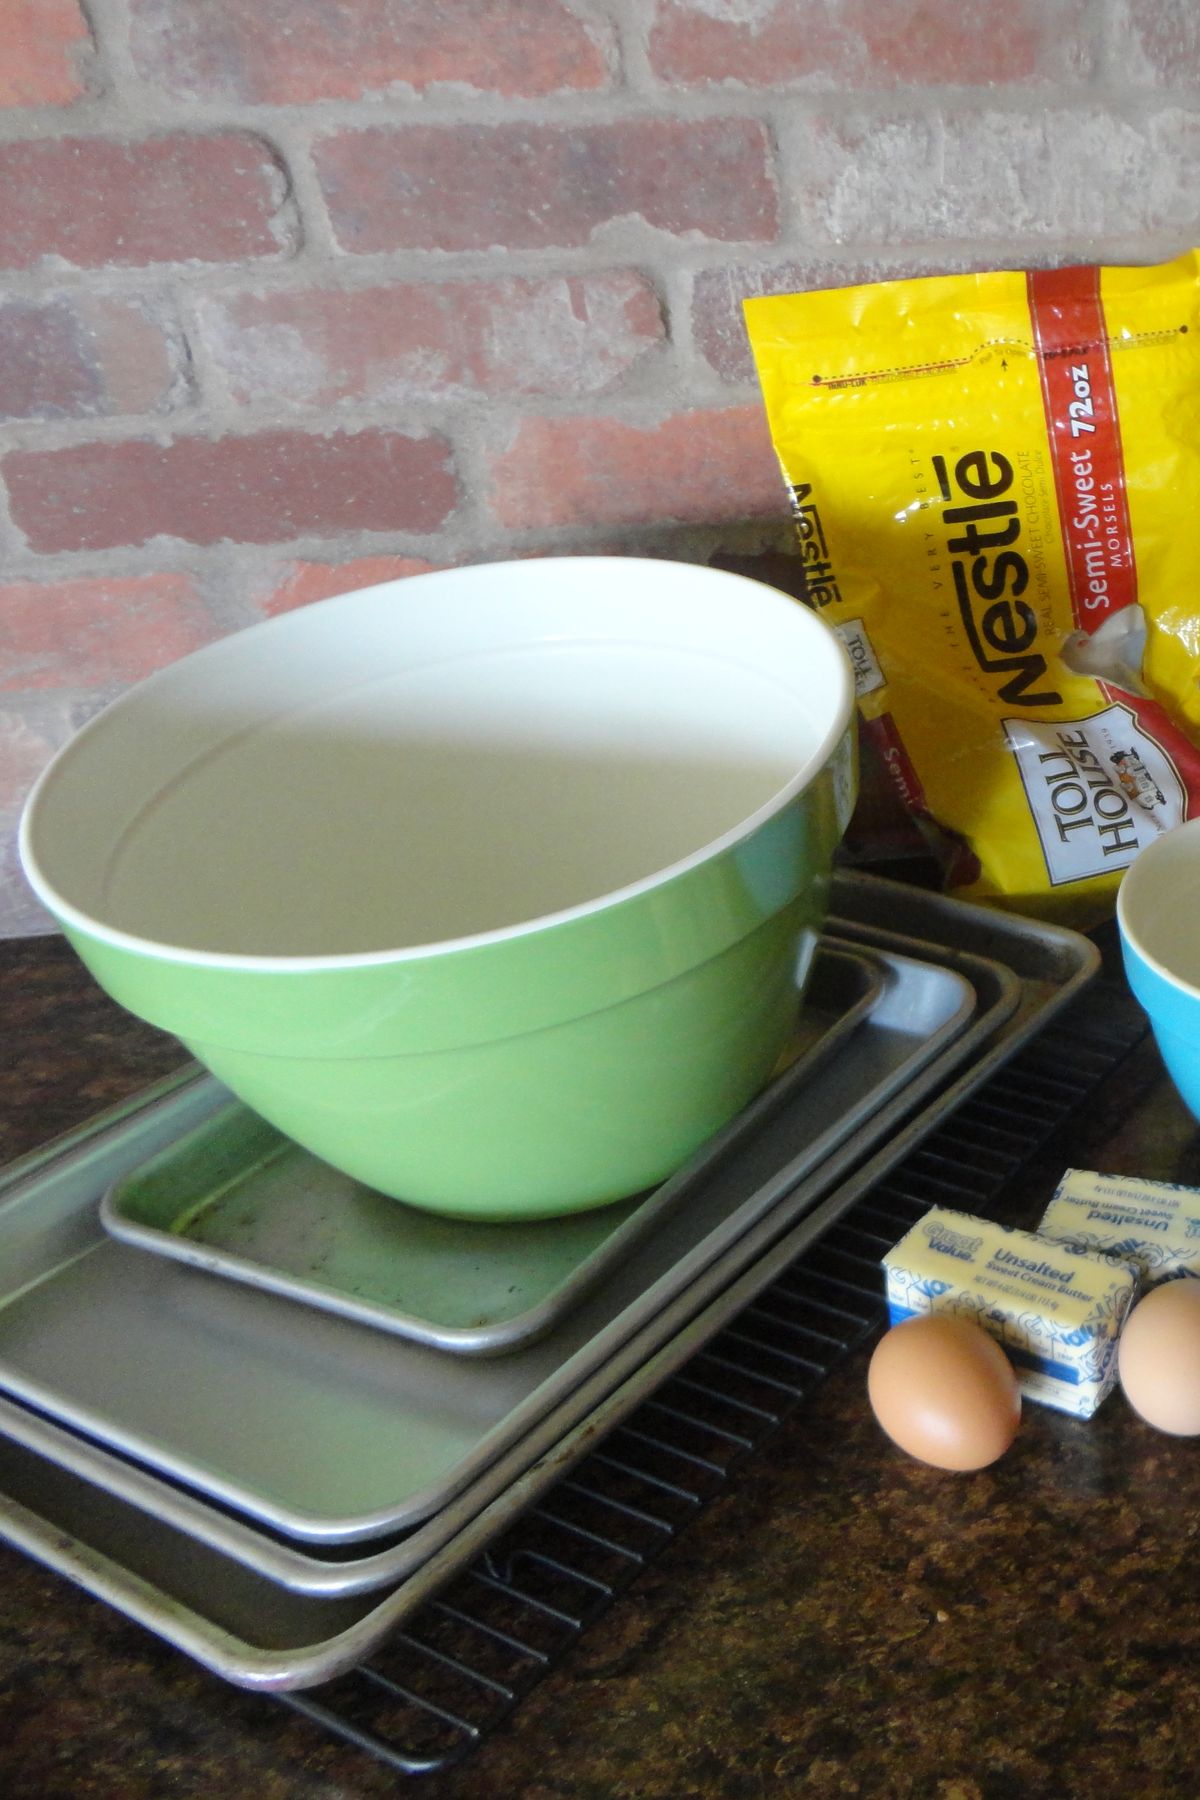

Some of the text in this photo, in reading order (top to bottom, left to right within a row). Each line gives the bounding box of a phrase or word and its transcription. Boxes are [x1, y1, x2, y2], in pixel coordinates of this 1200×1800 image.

[1069, 363, 1098, 439] 72oz
[910, 456, 930, 510] BEST
[1016, 451, 1041, 524] CHOCOLATE
[1069, 449, 1110, 610] Semi-Sweet
[1100, 482, 1124, 568] MORSELS
[924, 531, 944, 590] VERY
[1027, 529, 1050, 602] SEMI-SWEET
[1038, 748, 1094, 843] TOLL
[1057, 730, 1139, 857] HOUSE
[1062, 1194, 1101, 1211] Butter
[1086, 1209, 1170, 1232] Unsalted
[1101, 1201, 1139, 1216] Cream
[1139, 1205, 1175, 1220] Sweet
[921, 1220, 984, 1252] Great
[984, 1261, 1020, 1279] Sweet
[1020, 1271, 1058, 1291] Cream
[1056, 1285, 1095, 1302] Butter
[993, 1247, 1076, 1284] Unsalted
